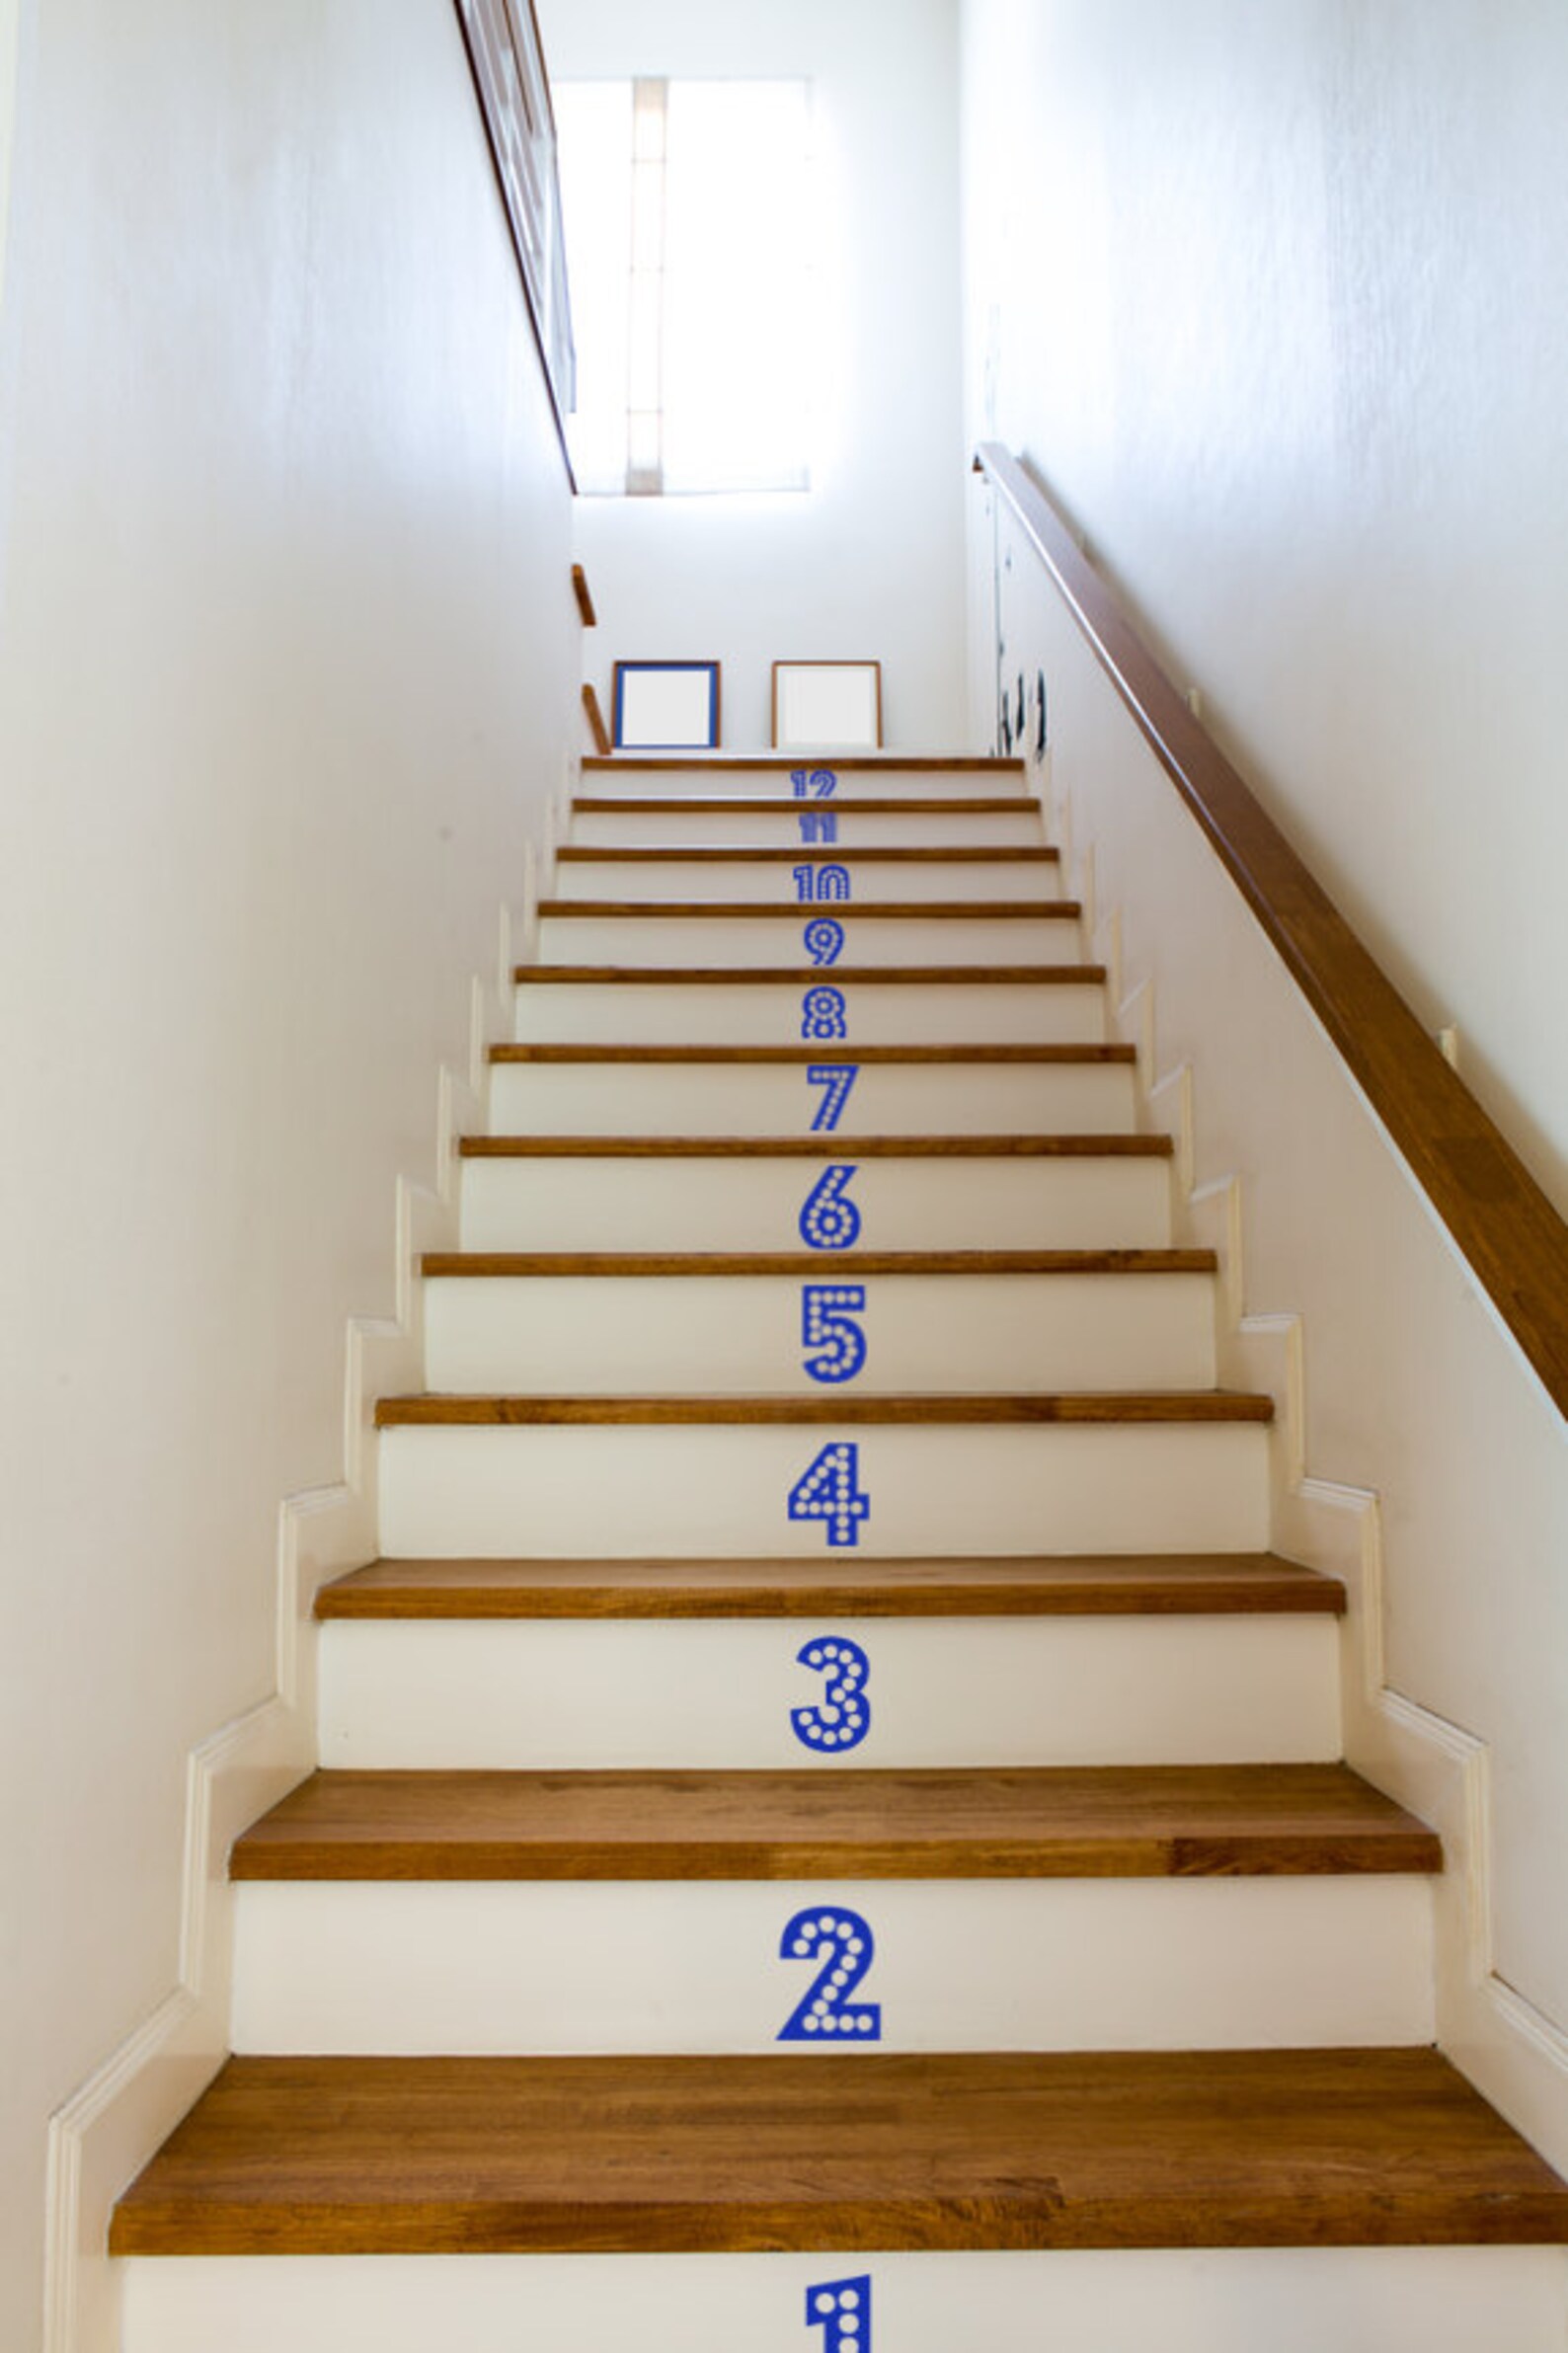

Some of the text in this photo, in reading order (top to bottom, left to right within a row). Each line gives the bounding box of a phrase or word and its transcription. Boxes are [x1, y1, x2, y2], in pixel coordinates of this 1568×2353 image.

[790, 769, 838, 799] 12
[792, 864, 850, 902] 10
[803, 917, 845, 967] 9
[801, 985, 847, 1040] 8
[807, 1064, 859, 1132] 7
[798, 1164, 861, 1250] 6
[802, 1285, 867, 1383] 5
[787, 1442, 870, 1547] 4
[789, 1635, 871, 1754] 3
[775, 1905, 882, 2042] 2
[805, 2273, 872, 2353] 1
